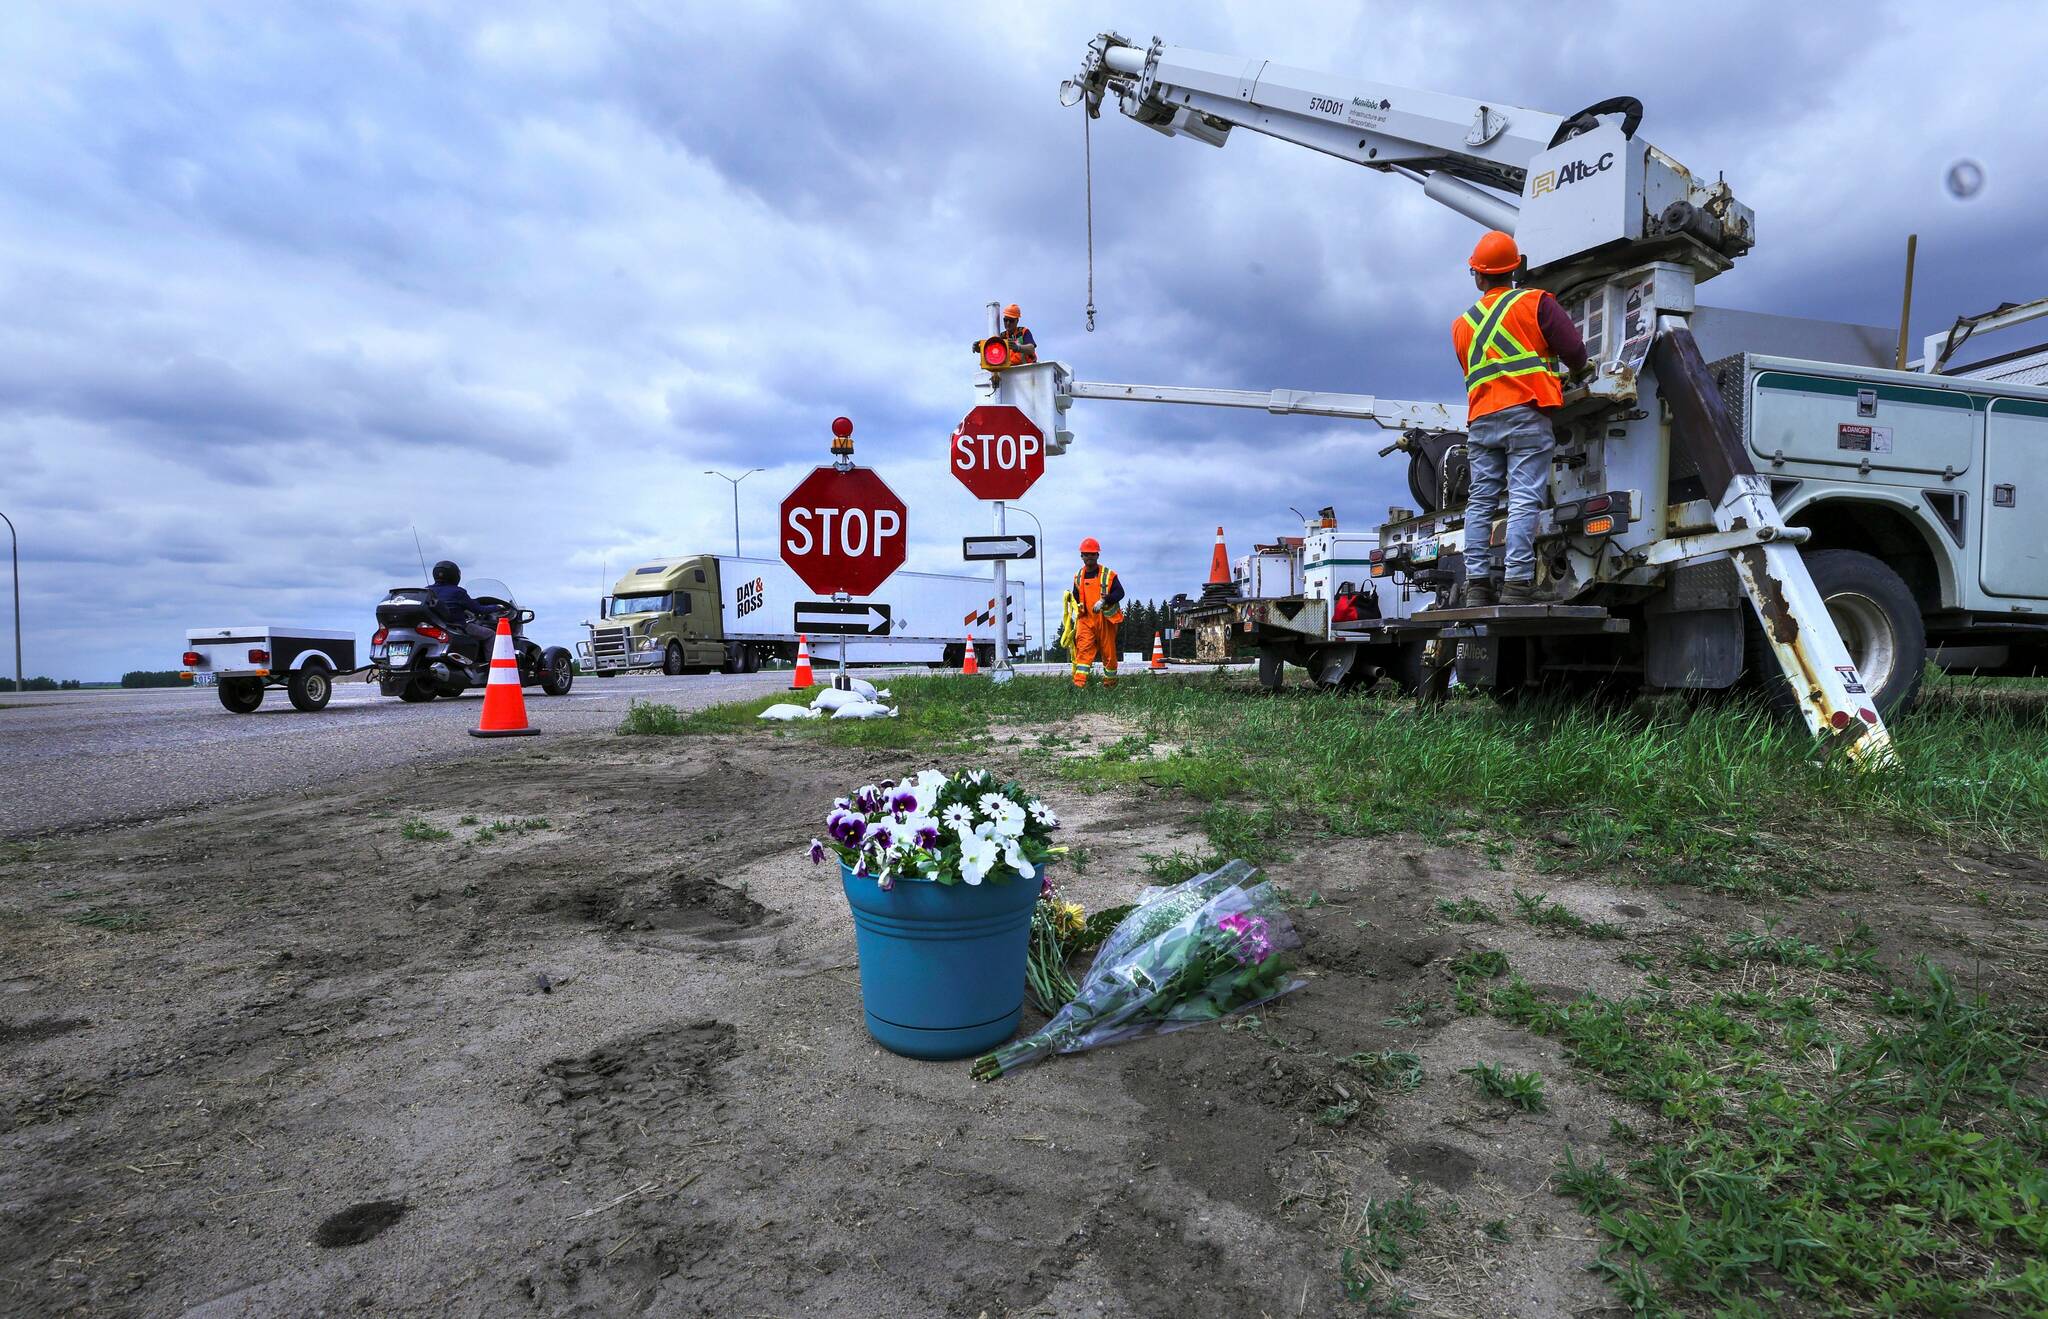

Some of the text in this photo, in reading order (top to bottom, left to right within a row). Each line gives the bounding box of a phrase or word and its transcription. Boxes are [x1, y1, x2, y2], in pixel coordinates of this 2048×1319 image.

[1309, 97, 1344, 116] 574D01
[1352, 96, 1379, 110] Manitoba
[1347, 116, 1377, 129] Transportation
[1349, 109, 1377, 121] Infrastructure
[1555, 152, 1614, 190] Altec
[1847, 426, 1870, 434] DANGER
[956, 434, 1039, 470] STOP
[786, 506, 901, 557] STOP
[737, 592, 763, 619] ROSS
[1464, 643, 1488, 660] Altec
